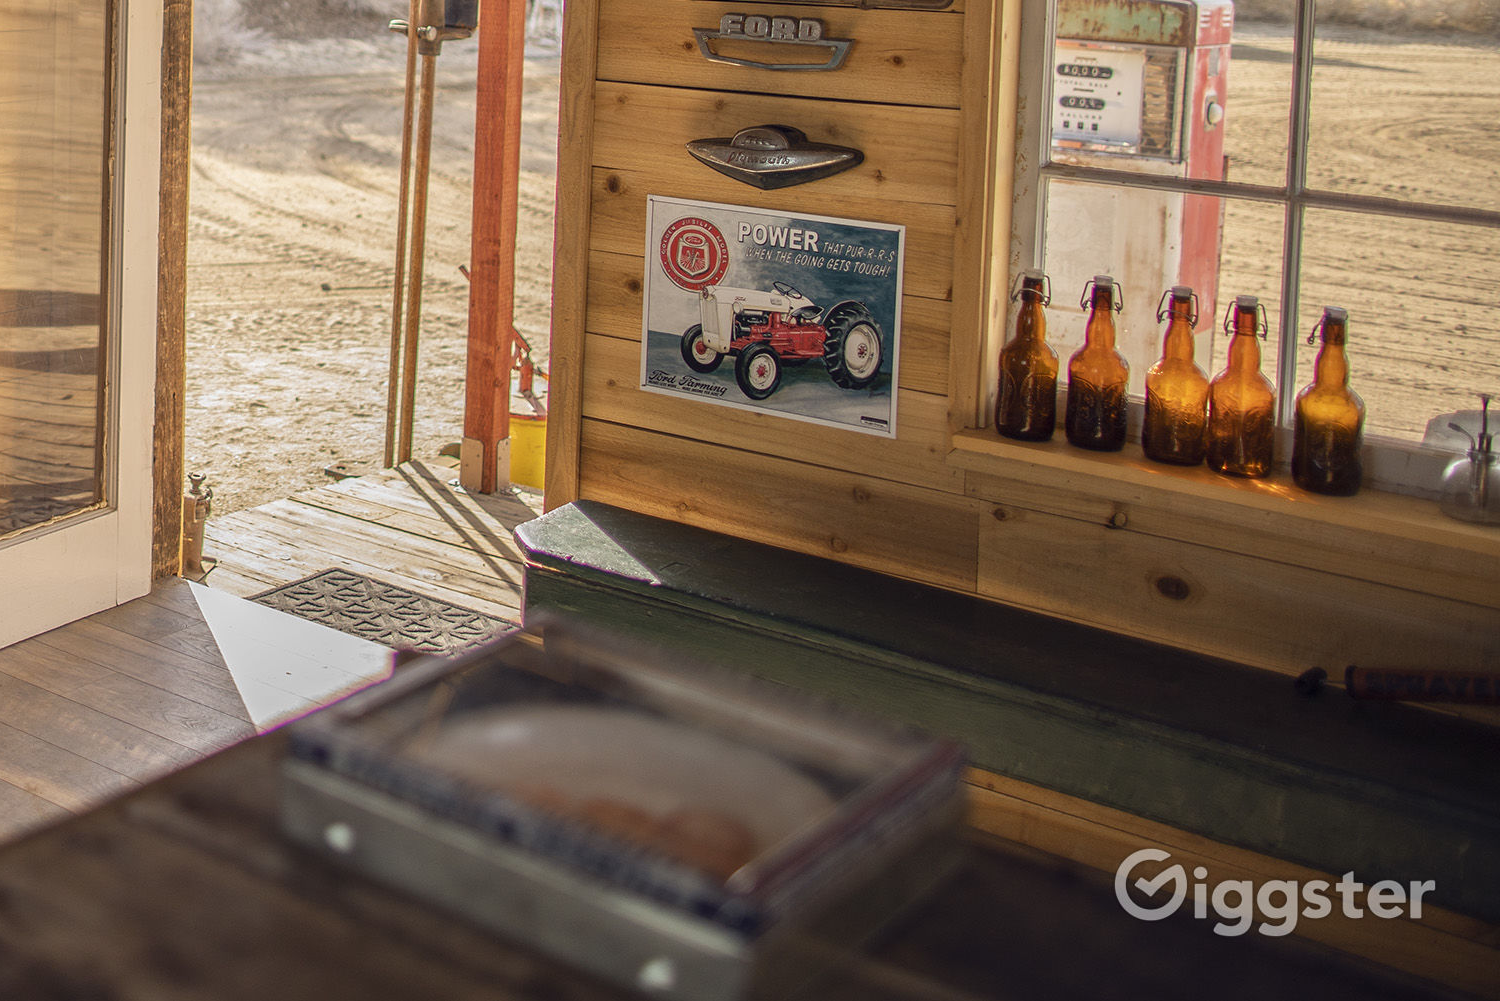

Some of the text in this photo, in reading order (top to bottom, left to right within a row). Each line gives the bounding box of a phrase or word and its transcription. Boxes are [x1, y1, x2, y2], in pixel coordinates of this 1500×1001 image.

[718, 13, 823, 42] FORD
[737, 221, 896, 263] POWER THAT PUR-R-R-S
[745, 246, 891, 278] WHEN THE GOING GETS TOUGH!
[648, 369, 728, 397] Ford Farming
